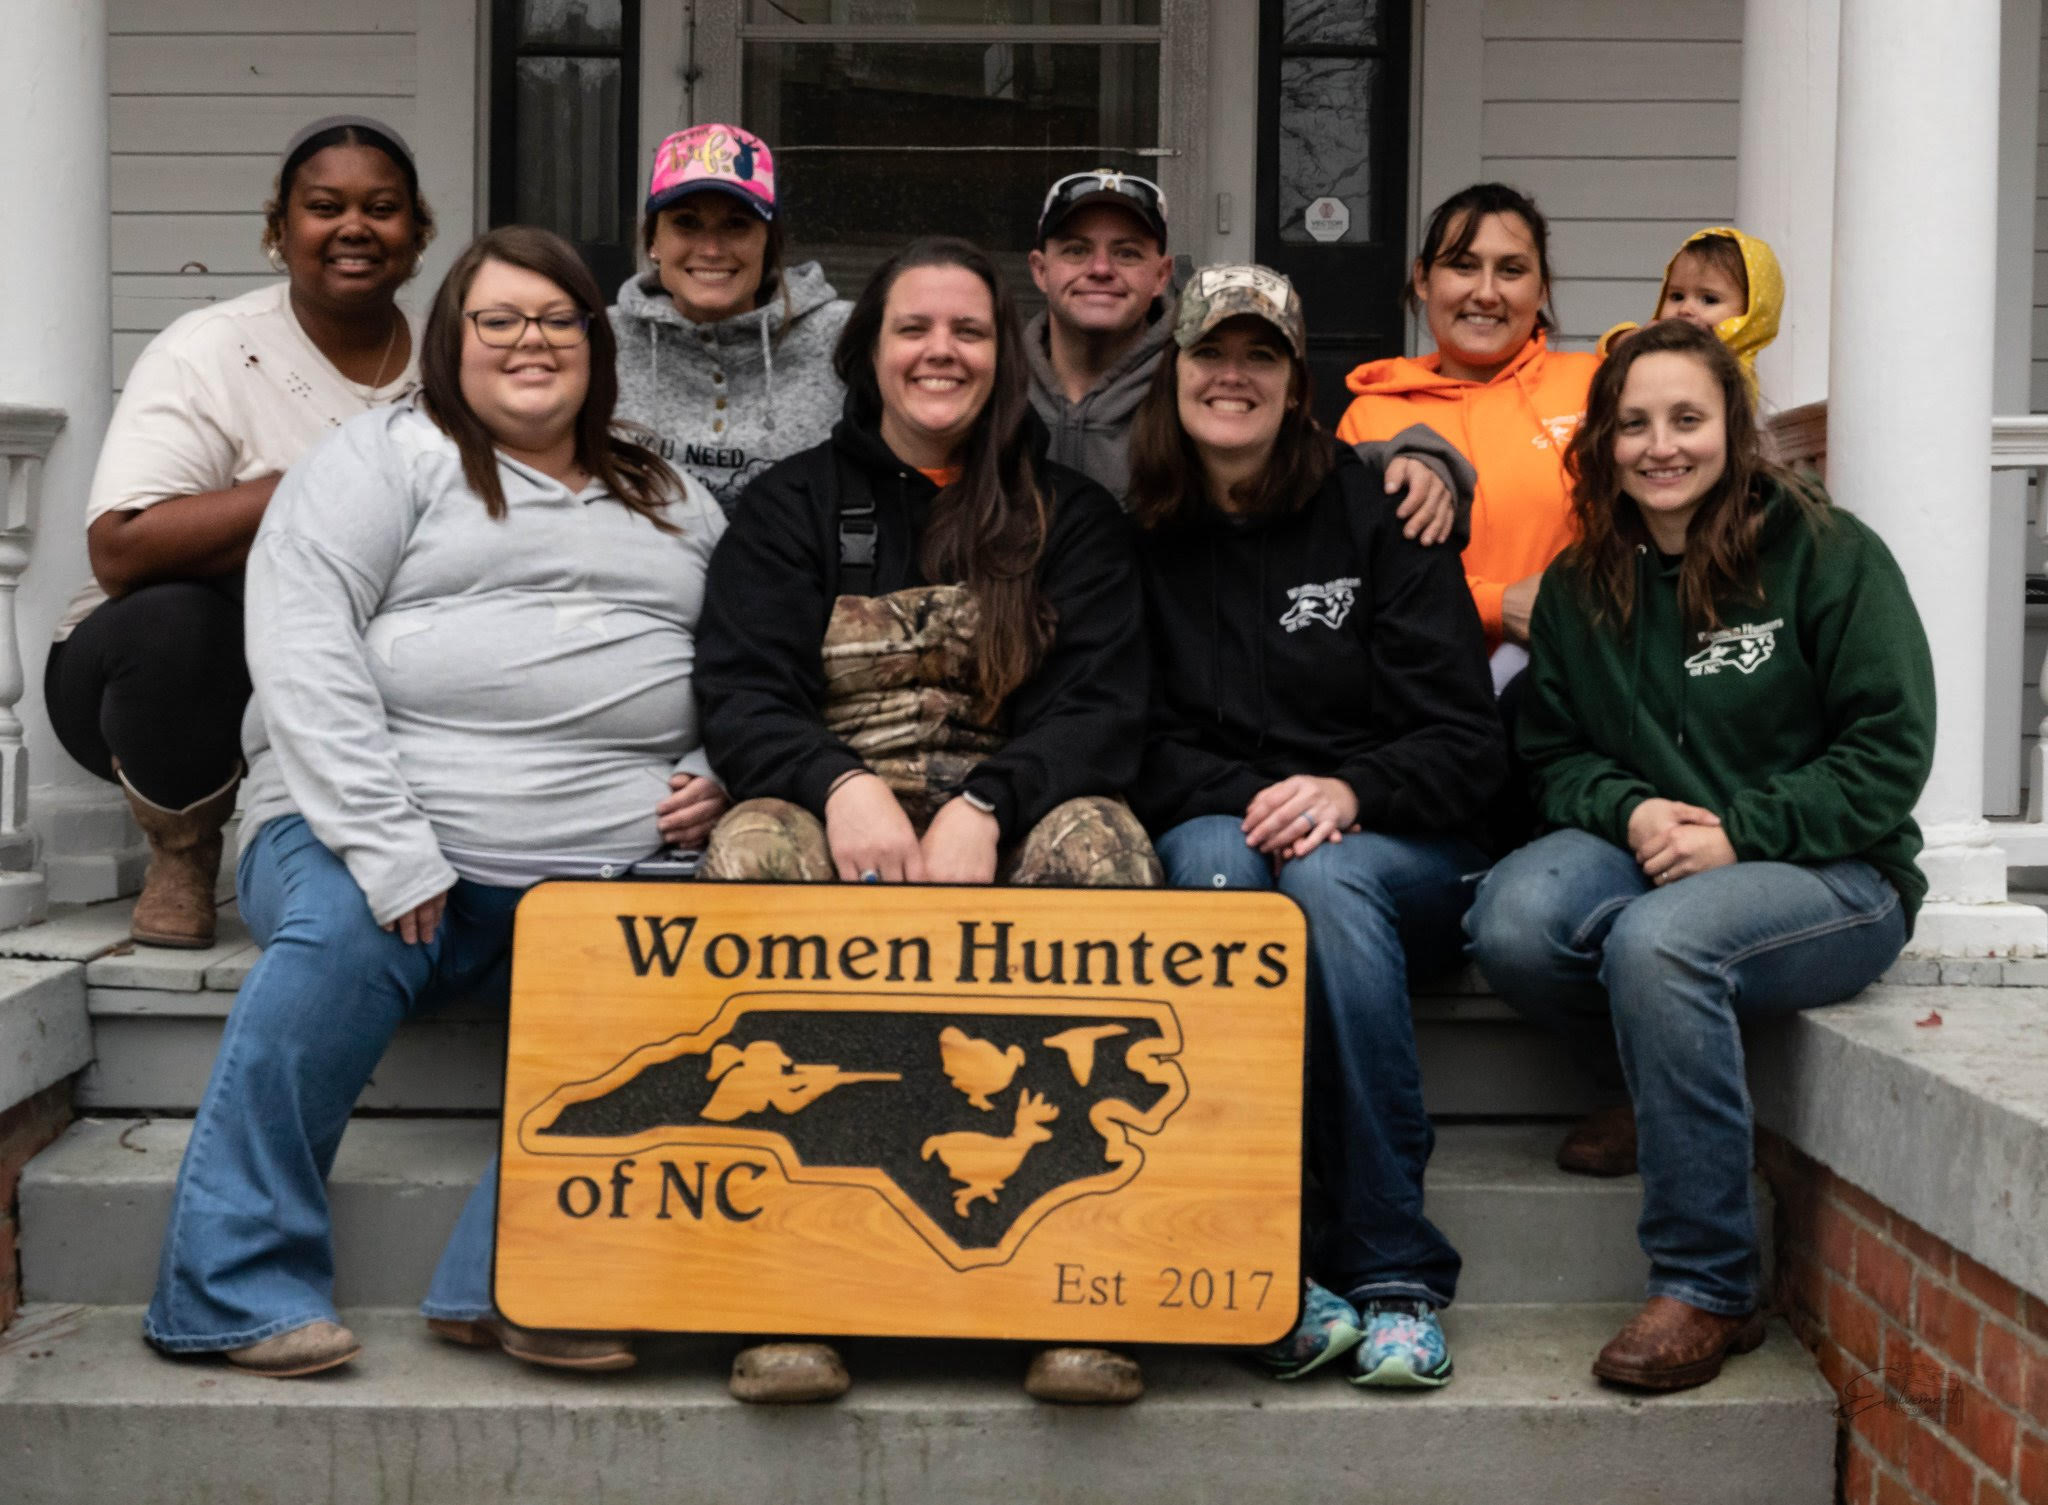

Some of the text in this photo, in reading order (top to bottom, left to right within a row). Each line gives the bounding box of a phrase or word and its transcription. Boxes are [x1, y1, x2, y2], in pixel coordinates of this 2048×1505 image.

[685, 443, 745, 469] NEED
[615, 914, 1288, 987] Women Hunters
[557, 1158, 768, 1223] of NC
[1052, 1262, 1275, 1312] Est 2017
